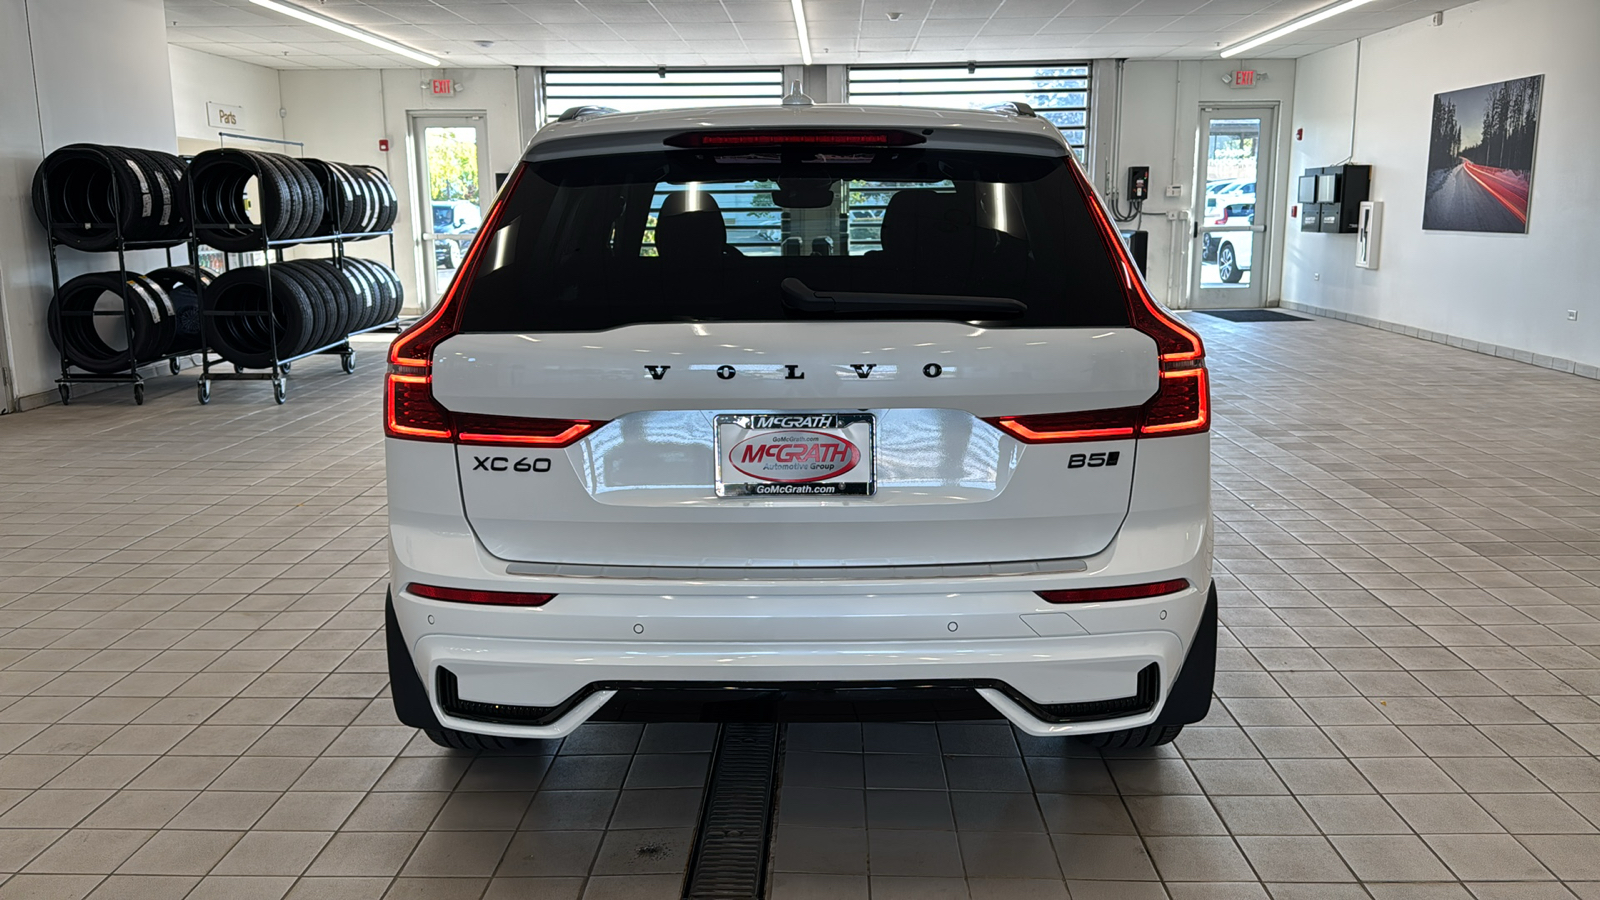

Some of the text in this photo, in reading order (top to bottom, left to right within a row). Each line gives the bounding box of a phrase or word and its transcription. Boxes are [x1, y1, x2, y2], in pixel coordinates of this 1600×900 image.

[1235, 70, 1255, 86] EXIT
[433, 79, 451, 94] EXIT
[218, 109, 237, 125] Parts
[644, 362, 943, 380] VOLVO
[763, 462, 835, 471] Automotive Group
[1067, 452, 1107, 469] B5
[756, 484, 836, 495] GoMcGrath.com
